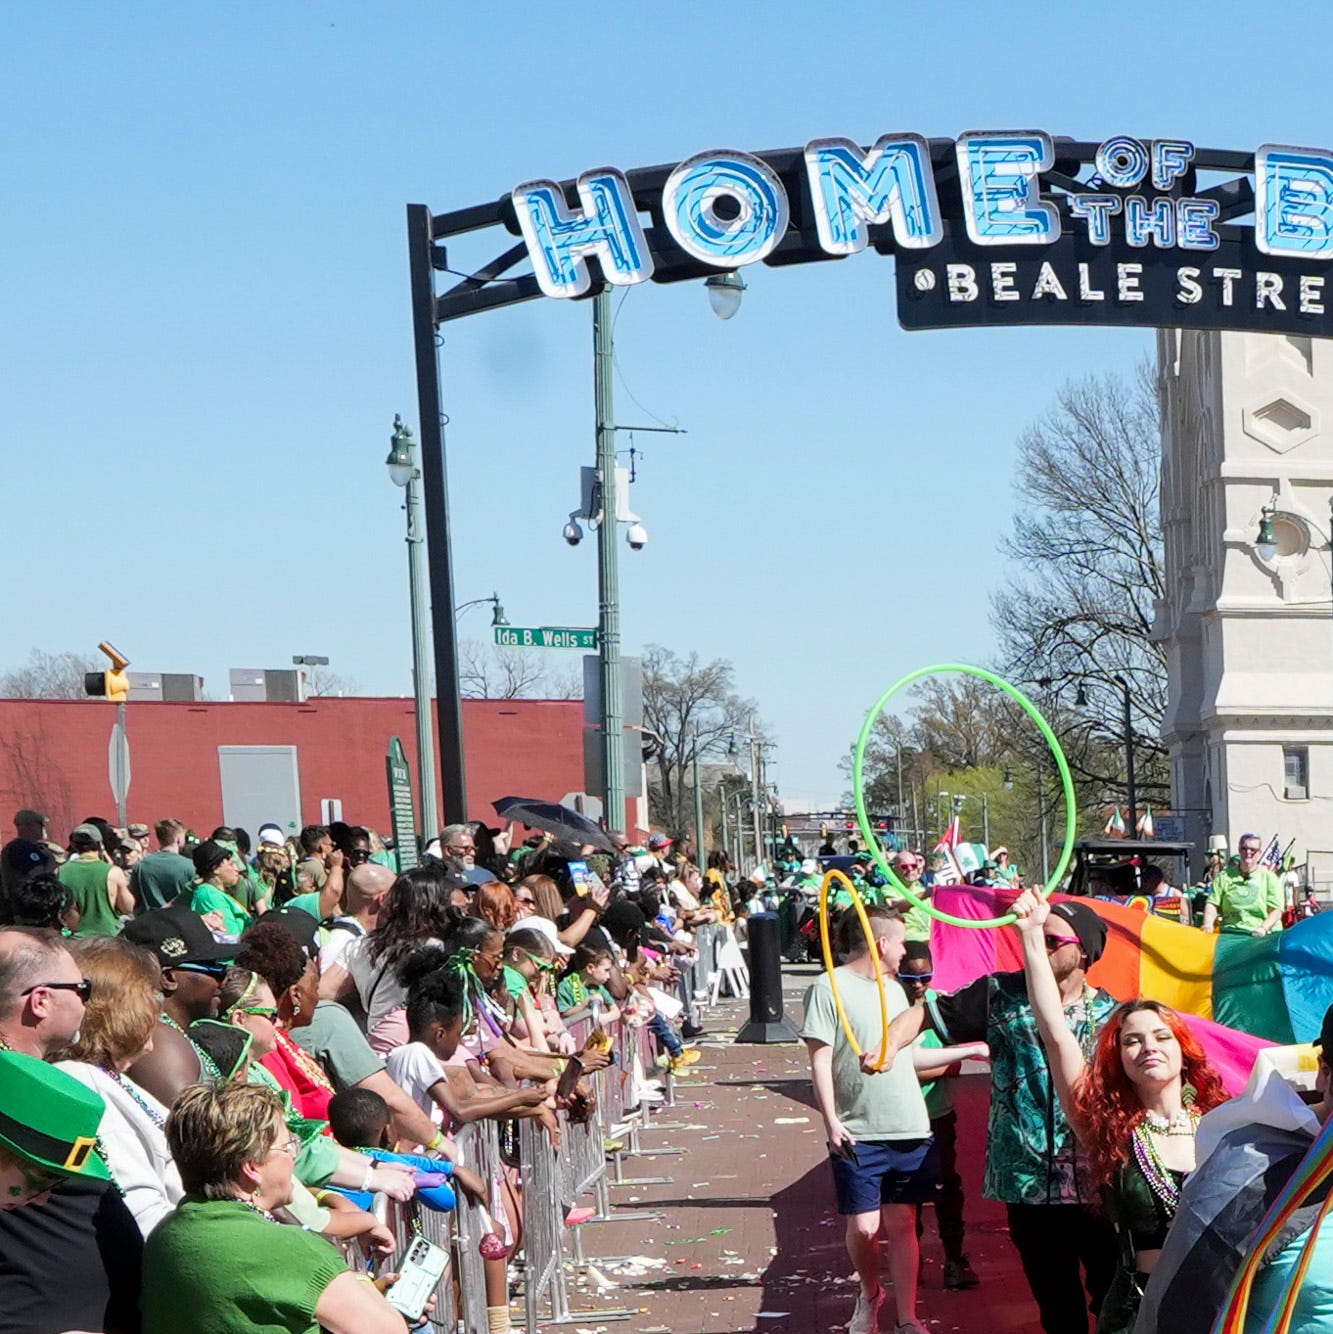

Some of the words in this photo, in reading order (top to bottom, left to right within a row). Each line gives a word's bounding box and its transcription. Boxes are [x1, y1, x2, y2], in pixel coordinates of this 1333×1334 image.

[1095, 135, 1195, 191] OF
[512, 129, 1061, 299] HOME
[1068, 195, 1220, 252] THE
[946, 262, 1145, 302] BEALE
[497, 629, 518, 645] Ida
[523, 630, 537, 646] B.
[542, 631, 578, 648] Wells
[582, 636, 595, 645] ST
